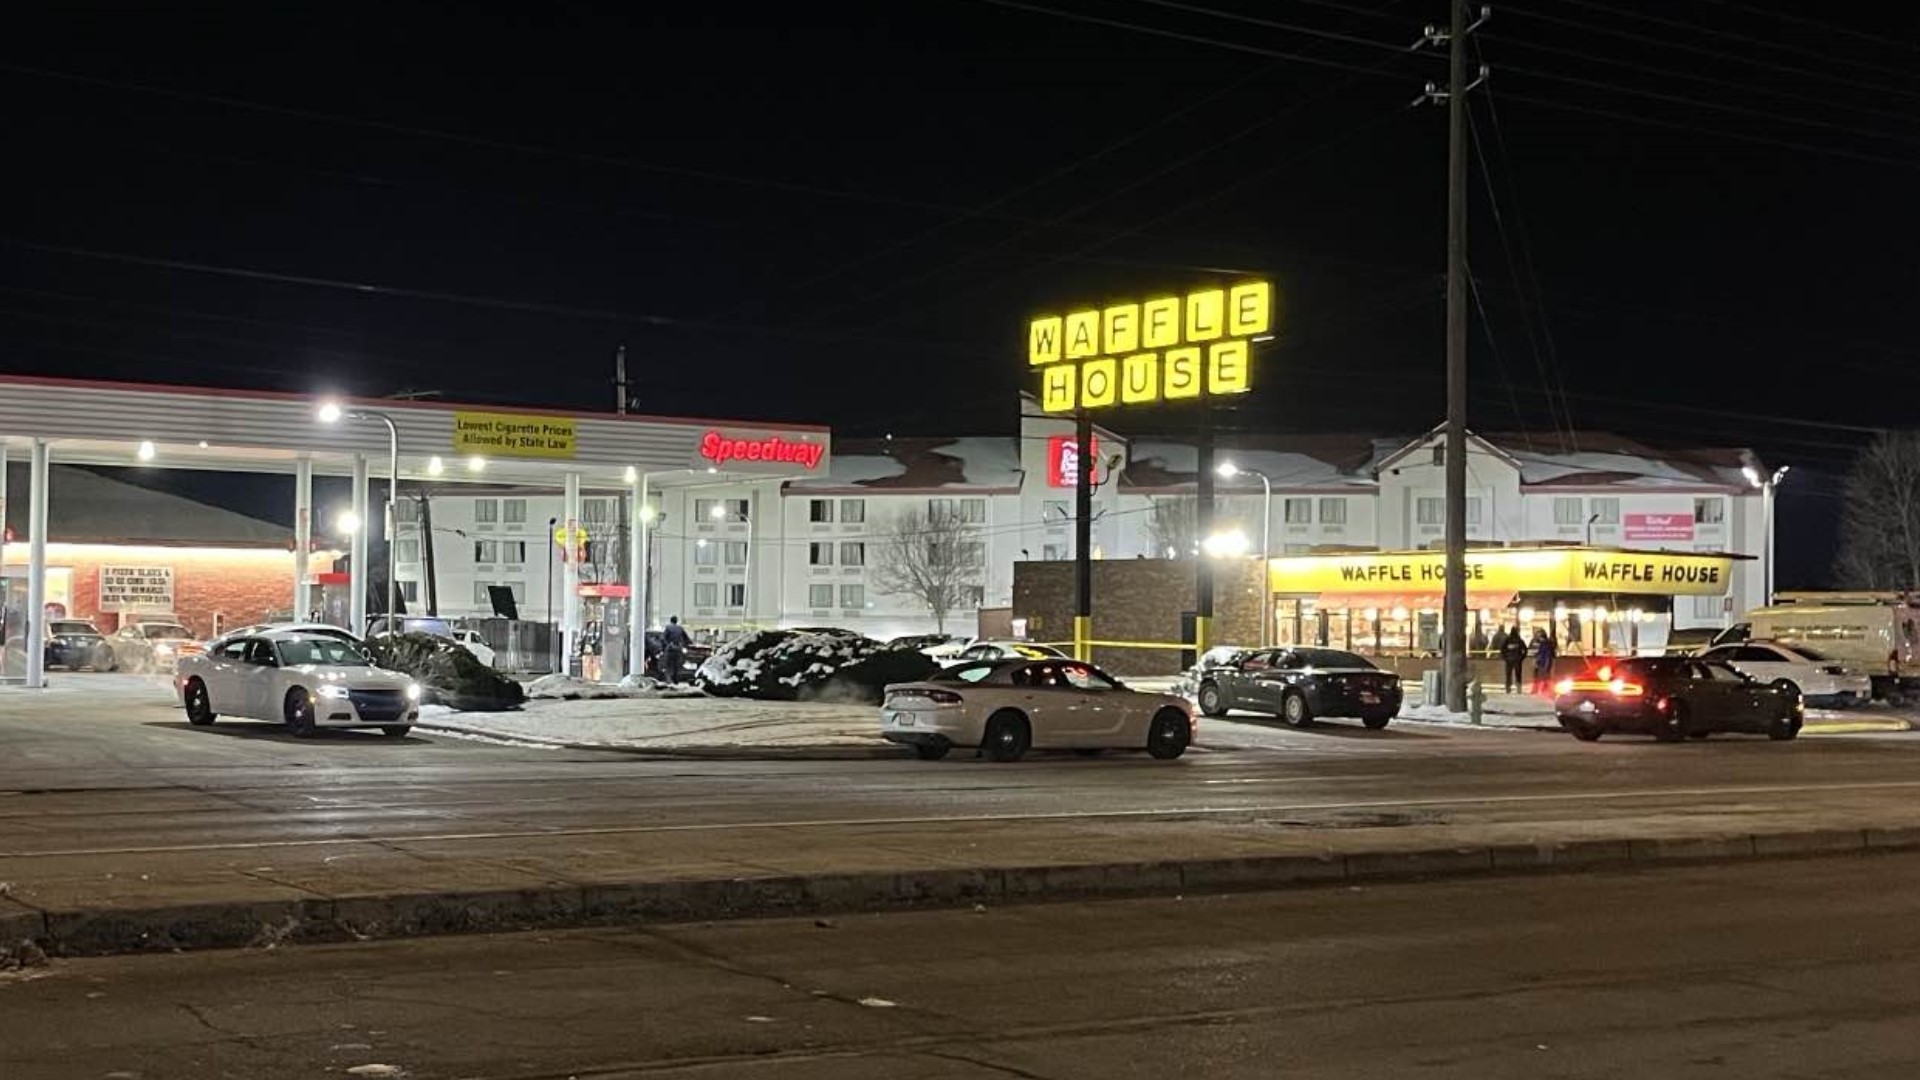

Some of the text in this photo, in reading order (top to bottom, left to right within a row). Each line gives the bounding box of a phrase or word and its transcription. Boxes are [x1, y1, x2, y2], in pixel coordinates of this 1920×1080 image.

[1036, 293, 1259, 356] WAFFLE
[1050, 349, 1238, 405] HOUSE
[458, 420, 573, 436] Lowest Cigarette Prices
[463, 433, 568, 449] Allowed by State Law
[702, 432, 823, 468] Speedway
[1341, 563, 1485, 581] WAFFLE HOSE
[1584, 561, 1719, 584] WAFFLE HOUSE
